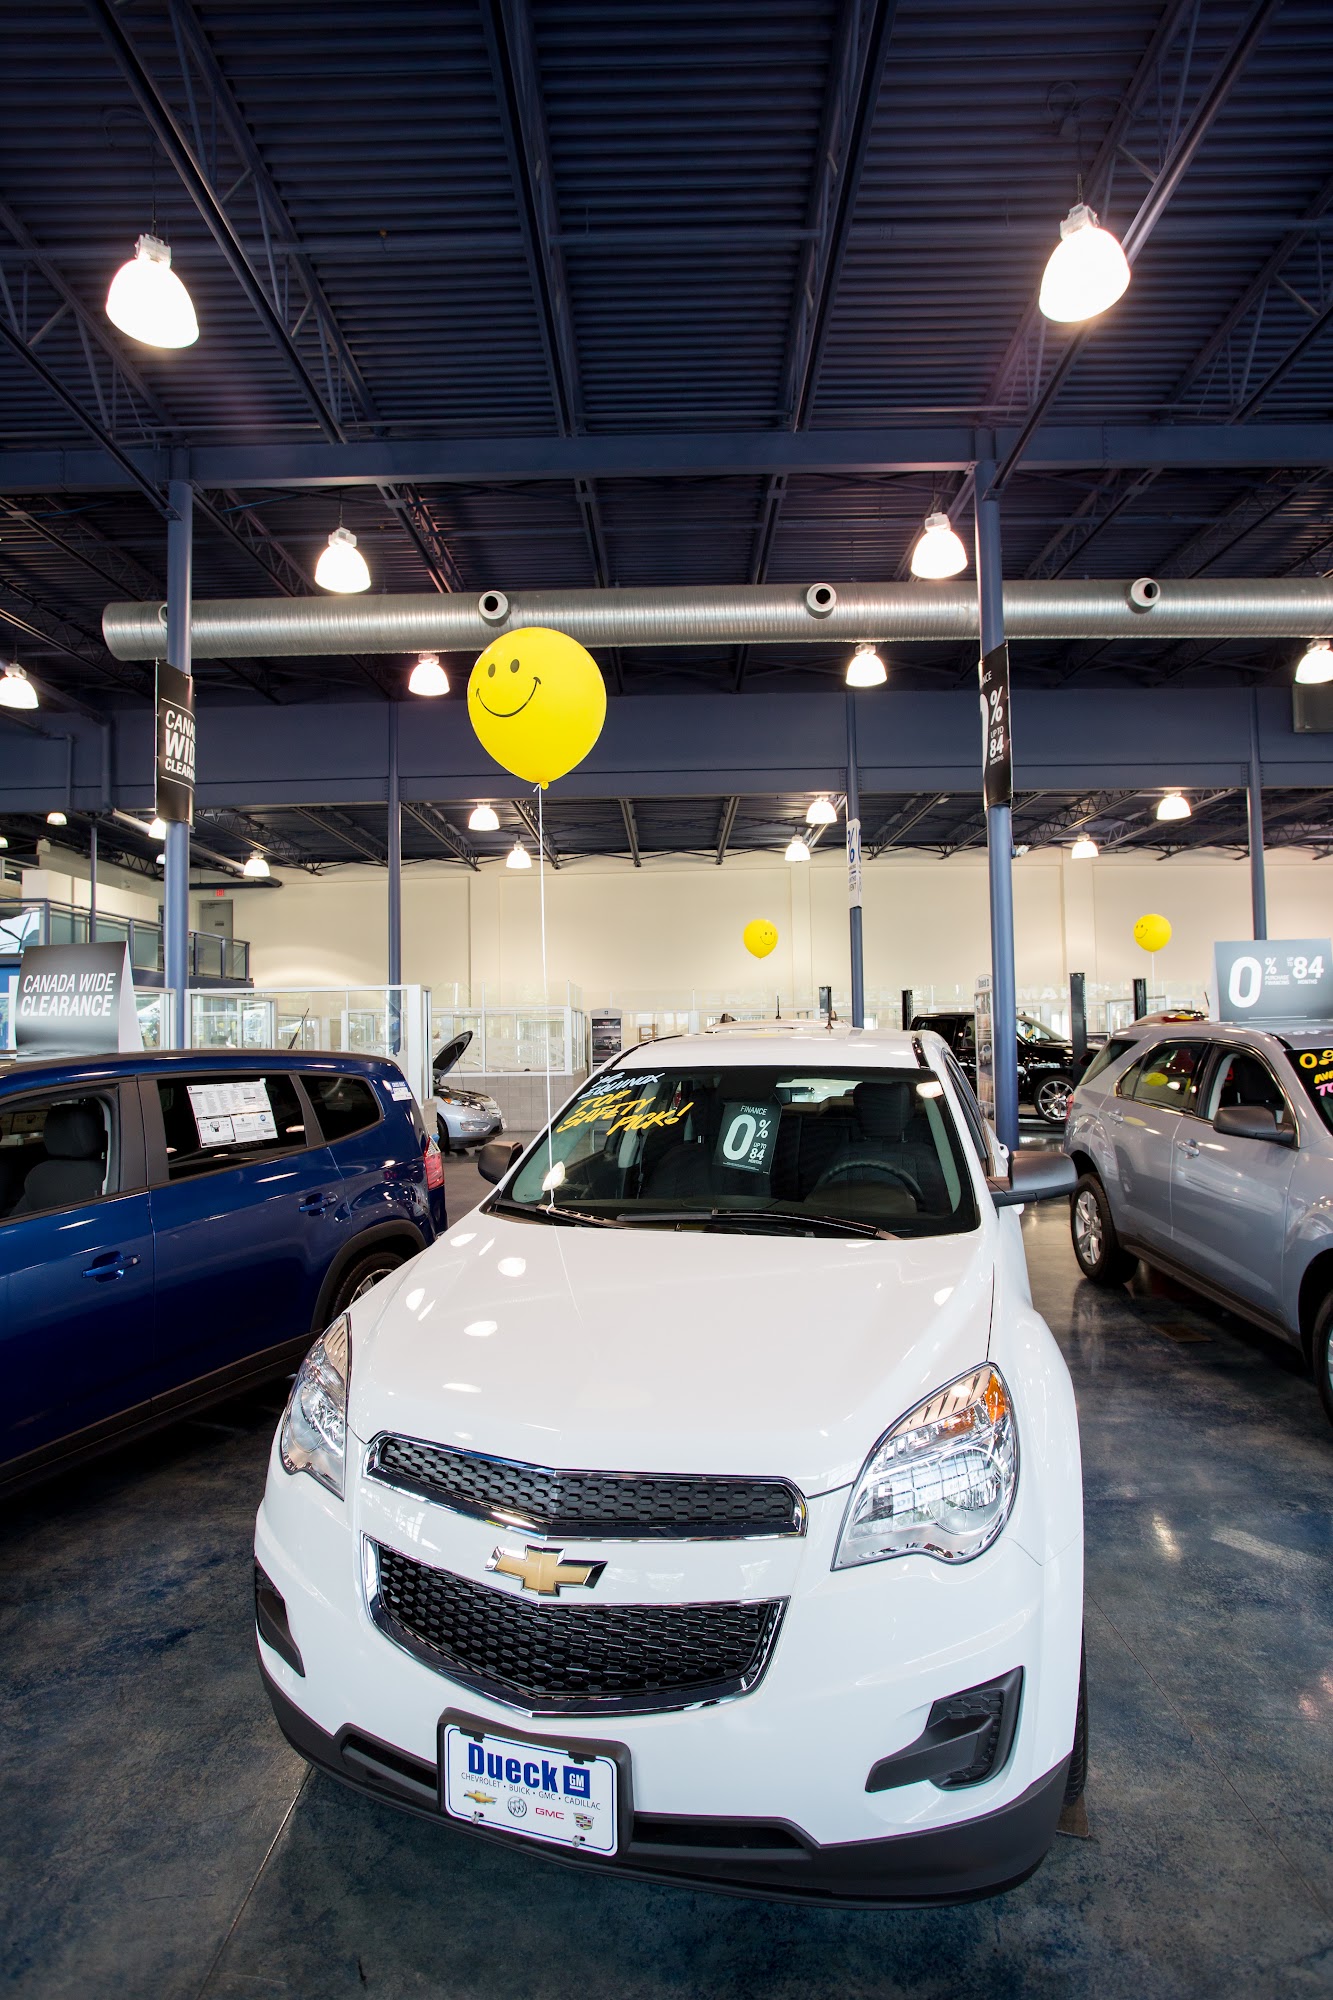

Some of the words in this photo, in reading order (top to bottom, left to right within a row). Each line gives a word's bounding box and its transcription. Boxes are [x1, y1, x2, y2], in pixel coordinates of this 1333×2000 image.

[165, 710, 195, 743] CANA
[165, 729, 195, 771] WID
[989, 734, 1004, 758] 84
[1292, 955, 1324, 979] 84
[23, 974, 76, 993] CANADA
[79, 973, 116, 992] WIDE
[20, 994, 114, 1017] CLEARANCE
[577, 1072, 666, 1100] EQUINOX
[575, 1089, 632, 1114] TOP
[740, 1105, 768, 1115] FINANCE
[556, 1096, 656, 1133] SAFETY
[749, 1148, 766, 1160] 84
[468, 1742, 558, 1793] Dueck
[569, 1772, 585, 1791] GM
[461, 1771, 501, 1788] CHEVROLET
[509, 1784, 530, 1796] BUICK
[538, 1790, 556, 1801] GMC
[564, 1796, 601, 1811] CADILLAC
[535, 1807, 565, 1820] GMC
